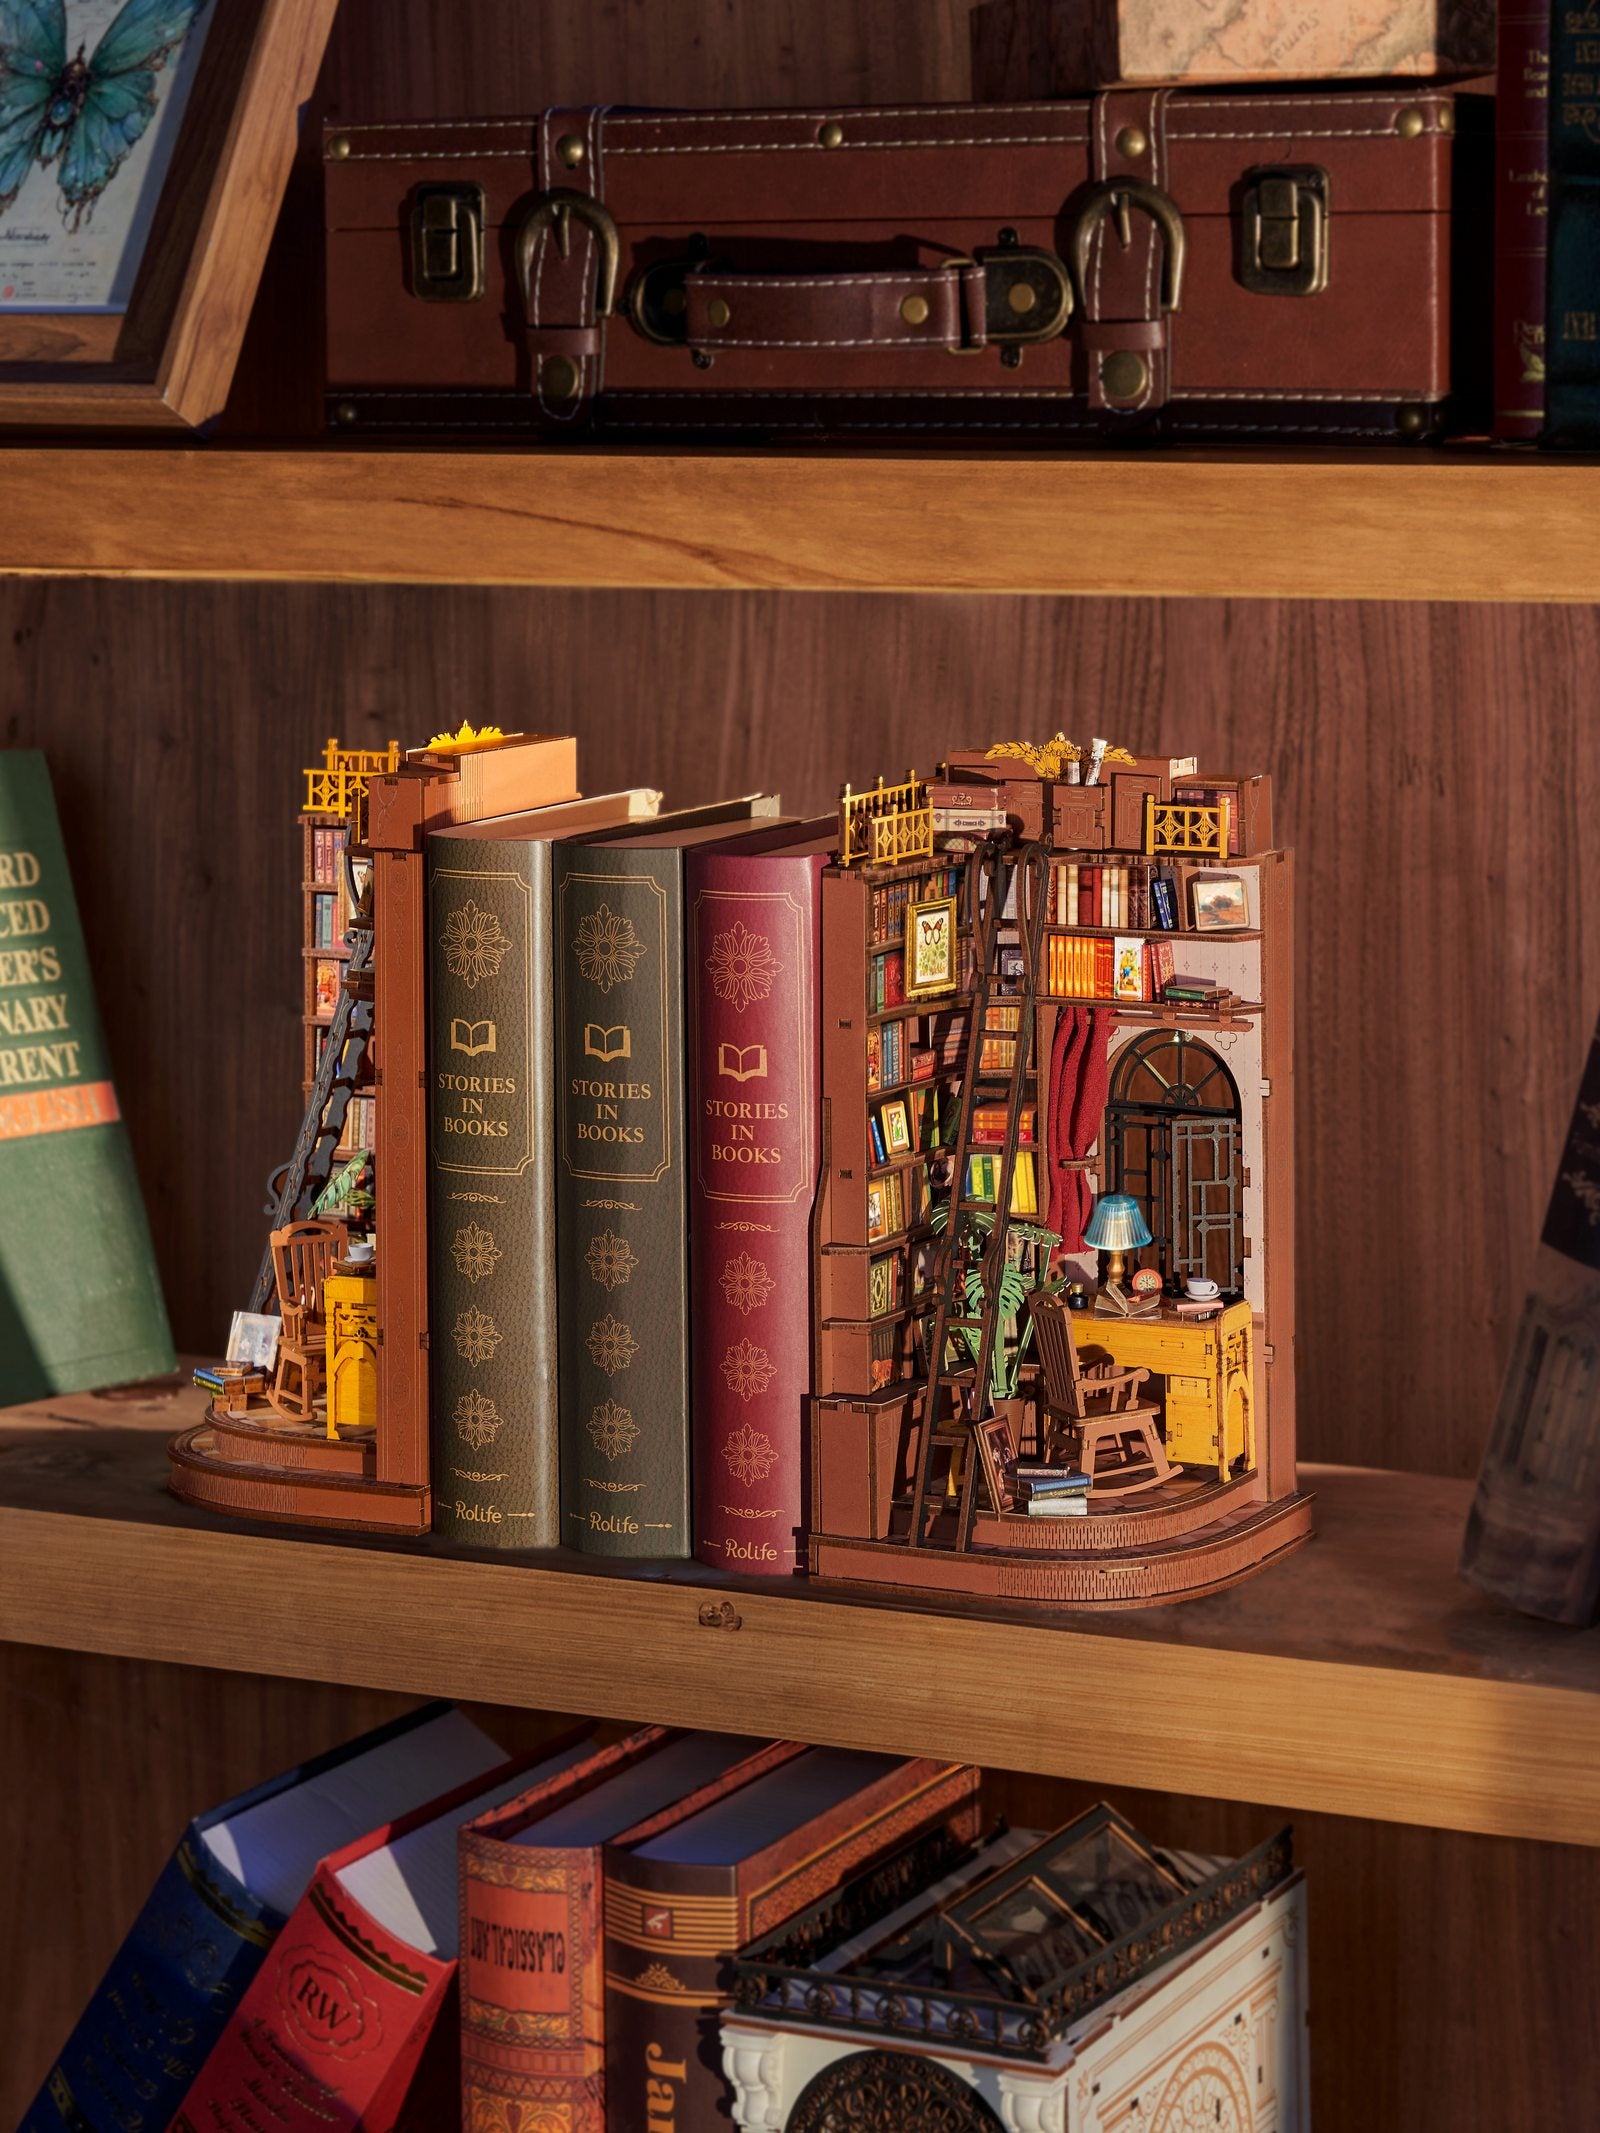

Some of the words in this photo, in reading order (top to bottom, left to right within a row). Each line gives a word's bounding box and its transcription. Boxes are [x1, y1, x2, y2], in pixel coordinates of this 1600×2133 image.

[438, 1072, 516, 1094] STORIES
[571, 1078, 652, 1100] STORIES
[461, 1097, 484, 1115] IN
[596, 1103, 619, 1121] IN
[705, 1099, 789, 1119] STORIES
[443, 1116, 509, 1137] BOOKS
[577, 1123, 645, 1143] BOOKS
[730, 1124, 755, 1141] IN
[711, 1144, 782, 1164] BOOKS
[455, 1500, 503, 1524] Rolife
[589, 1511, 639, 1535] Rolife
[725, 1538, 778, 1562] Rolife
[296, 1976, 351, 2030] RW
